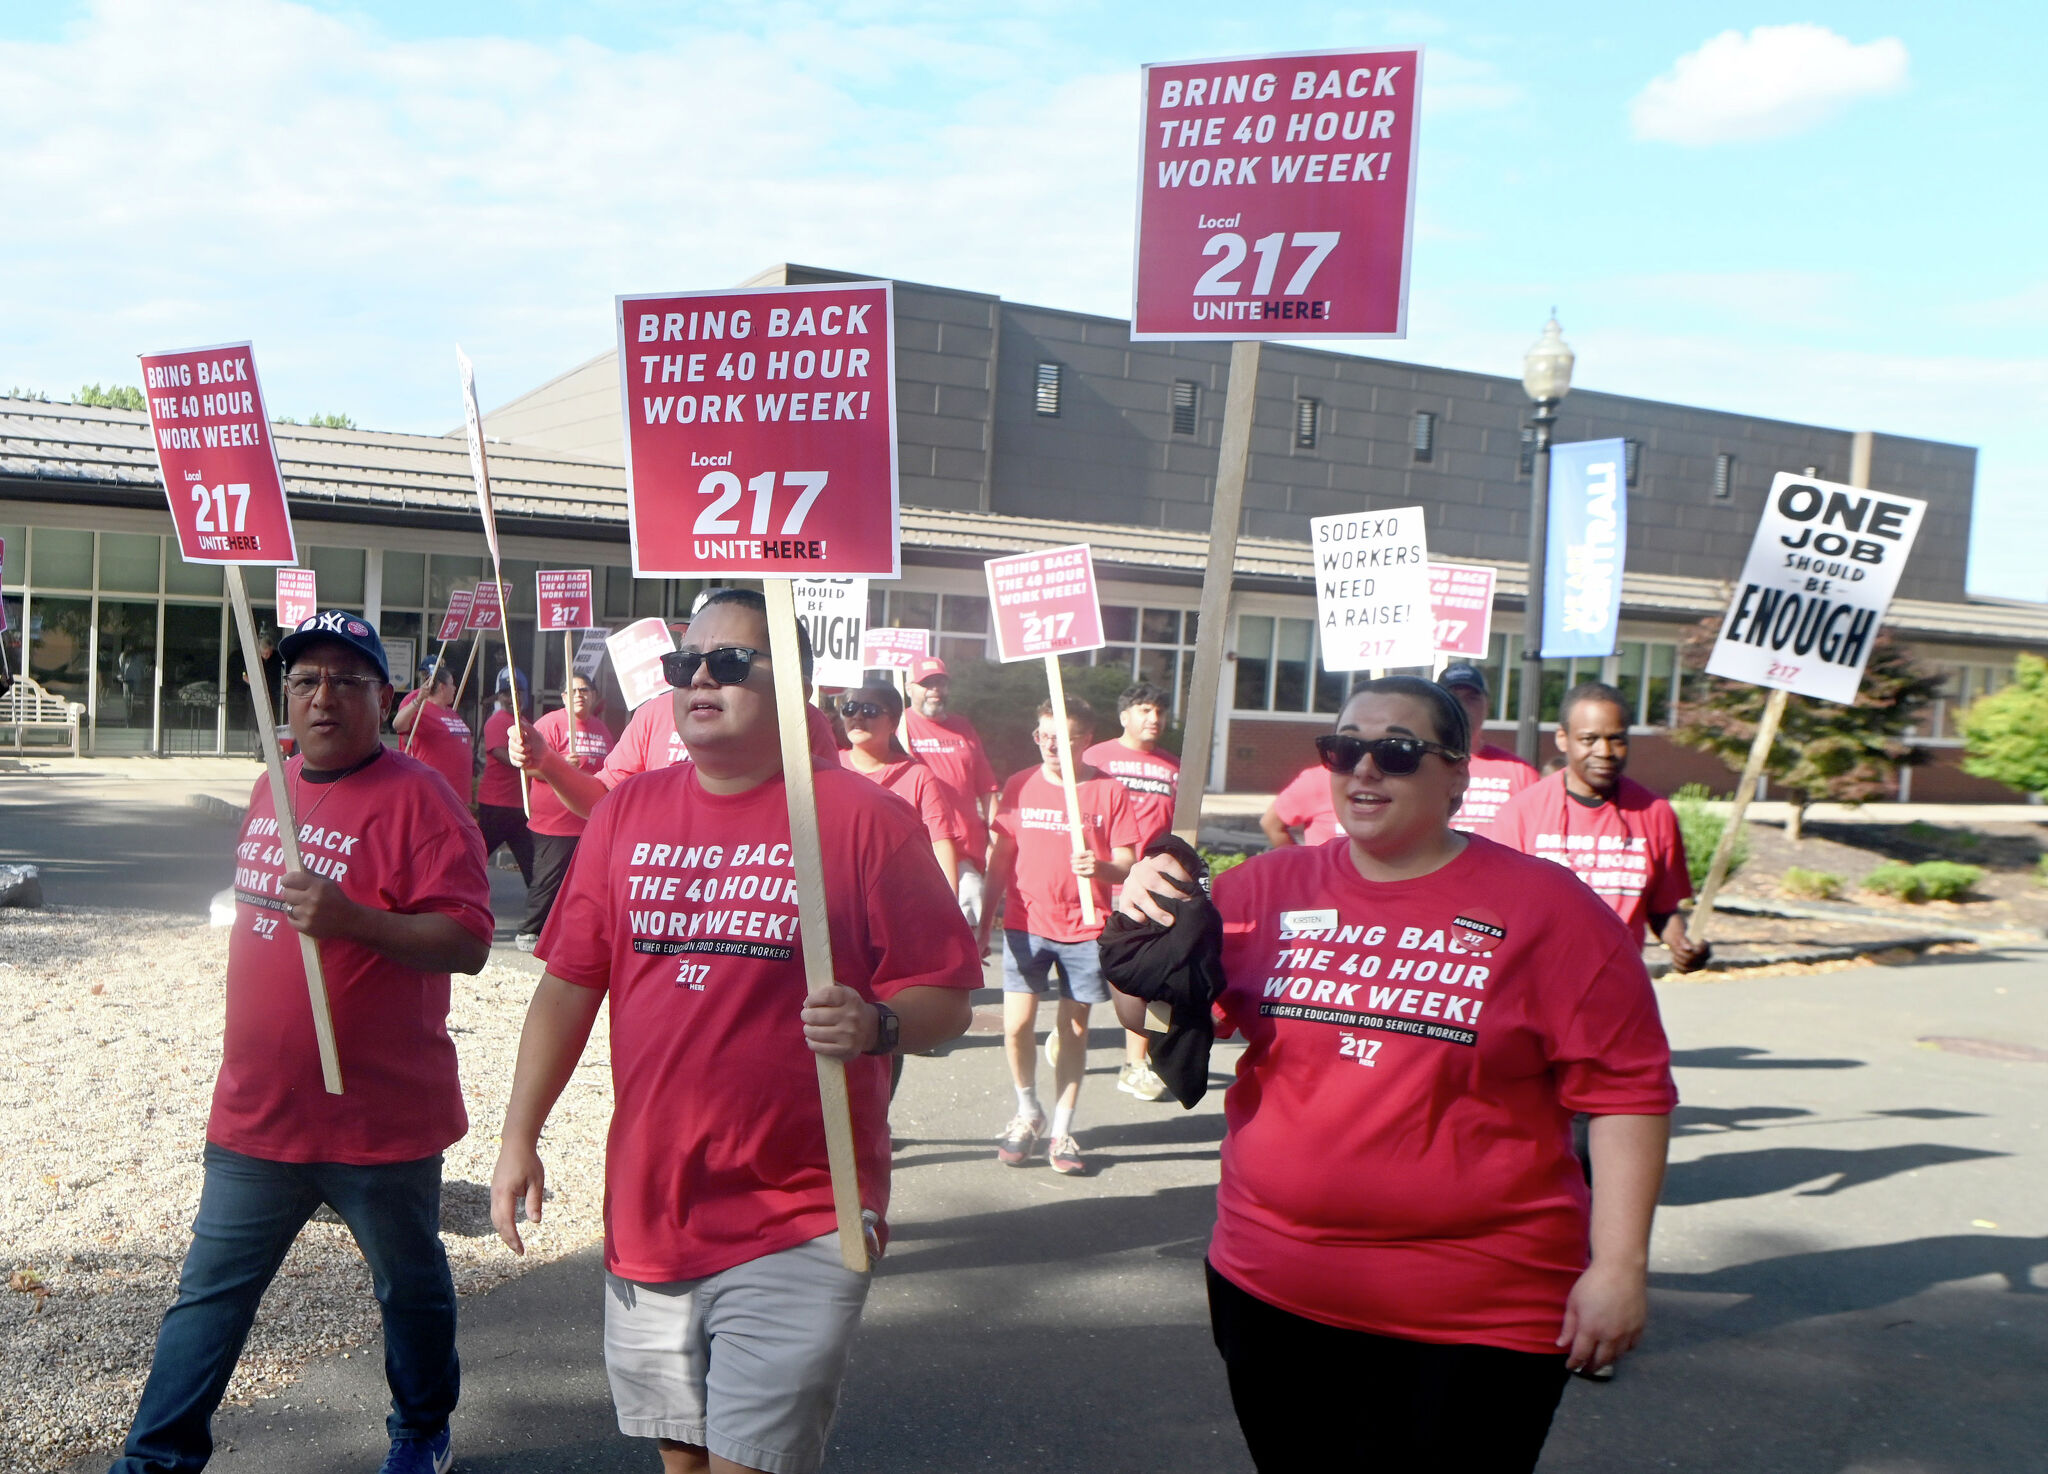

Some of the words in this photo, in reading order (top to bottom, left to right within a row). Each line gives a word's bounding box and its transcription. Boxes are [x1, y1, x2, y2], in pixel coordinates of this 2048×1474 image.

[1160, 73, 1279, 108] BRING
[1290, 66, 1402, 100] BACK
[1160, 117, 1226, 148] THE
[1232, 114, 1277, 144] 40
[1285, 110, 1396, 142] HOUR
[1158, 156, 1263, 188] WORK
[1270, 152, 1392, 184] WEEK!
[1198, 212, 1241, 229] Local
[1192, 231, 1341, 296] 217
[638, 310, 752, 342] BRING
[768, 304, 872, 338] BACK
[147, 364, 192, 389] BRING
[197, 358, 248, 385] BACK
[640, 354, 707, 384] THE
[716, 352, 756, 381] 40
[767, 348, 870, 380] HOUR
[152, 397, 179, 419] THE
[181, 395, 200, 418] 40
[202, 391, 254, 417] HOUR
[643, 394, 746, 424] WORK
[756, 391, 871, 422] WEEK!
[158, 427, 201, 450] WORK
[202, 424, 260, 449] WEEK!
[690, 451, 732, 466] Local
[184, 470, 202, 481] Local
[192, 484, 250, 532] 217
[692, 470, 829, 535] 217
[1778, 484, 1912, 541] ONE
[1319, 518, 1399, 543] SODEXO
[1322, 546, 1420, 571] WORKERS
[1780, 528, 1887, 565] JOB
[540, 574, 564, 582] BRING
[995, 560, 1040, 578] BRING
[1044, 553, 1083, 570] BACK
[1783, 554, 1866, 582] SHOULD
[541, 582, 556, 590] THE
[566, 582, 588, 590] HOUR
[797, 587, 845, 598] HOULD
[997, 577, 1024, 592] THE
[1025, 574, 1043, 588] 40
[1045, 568, 1085, 584] HOUR
[1324, 578, 1376, 600] NEED
[1804, 577, 1832, 595] BE
[542, 590, 564, 598] WORK
[564, 590, 588, 598] WEEK!
[999, 590, 1040, 606] WORK
[1042, 582, 1087, 600] WEEK!
[286, 604, 306, 620] 217
[318, 612, 346, 634] NY
[476, 611, 496, 623] 217
[552, 606, 580, 622] 217
[1325, 610, 1337, 629] A
[1345, 604, 1412, 626] RAISE!
[1022, 612, 1074, 642] 217
[1726, 584, 1878, 668] ENOUGH
[1359, 640, 1396, 657] 217
[1766, 663, 1801, 679] 217
[1109, 760, 1143, 776] COME
[247, 818, 281, 838] BRIN
[298, 824, 360, 856] BACK
[261, 845, 284, 866] 40
[300, 851, 348, 882] OUR
[630, 842, 724, 868] BRING
[730, 843, 794, 868] BAC
[628, 876, 681, 900] THE
[684, 878, 719, 903] 40
[720, 876, 799, 905] HOUR
[252, 916, 279, 934] 217
[629, 910, 706, 937] WORK
[704, 910, 800, 942] WEEK!
[1452, 918, 1490, 932] AUGUST
[1490, 928, 1502, 937] 26
[696, 942, 714, 952] FOOD
[714, 942, 748, 954] SERVICE
[750, 944, 791, 959] WORKERS
[1462, 932, 1484, 944] 217
[676, 964, 710, 984] 217
[1274, 948, 1336, 972] THE
[1339, 953, 1382, 978] 40
[1387, 959, 1490, 990] HOUR
[1262, 976, 1362, 1006] WORK
[1367, 985, 1484, 1026] WEEK!
[1270, 1006, 1302, 1018] HIGHER
[1304, 1008, 1356, 1024] EDUCATION
[1358, 1015, 1383, 1028] FOOD
[1385, 1019, 1426, 1034] SERVICE
[1426, 1026, 1474, 1044] WORKERS
[1338, 1036, 1383, 1060] 217
